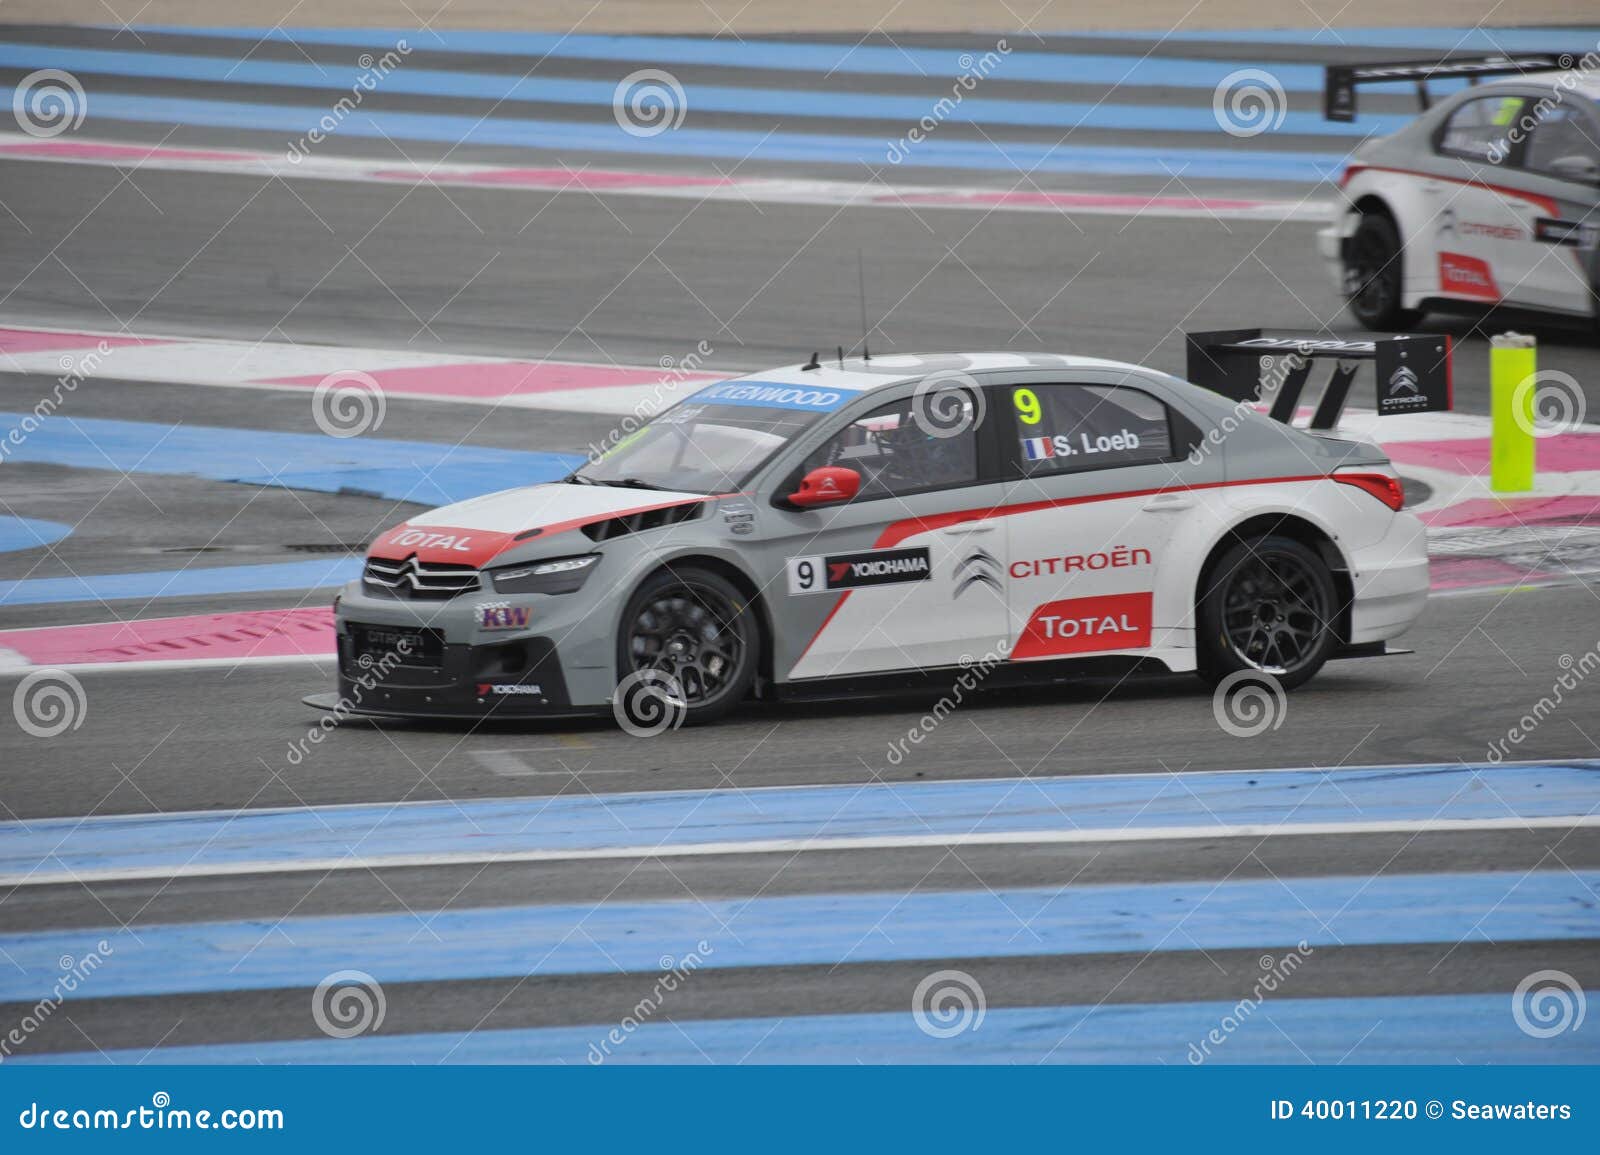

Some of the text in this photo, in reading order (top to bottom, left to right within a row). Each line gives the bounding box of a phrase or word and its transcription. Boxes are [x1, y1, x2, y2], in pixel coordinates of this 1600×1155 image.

[1013, 388, 1042, 425] 9
[1053, 429, 1140, 457] S. Loeb
[797, 557, 928, 589] 9 YOKOHAMA
[1038, 614, 1139, 638] TOTAL
